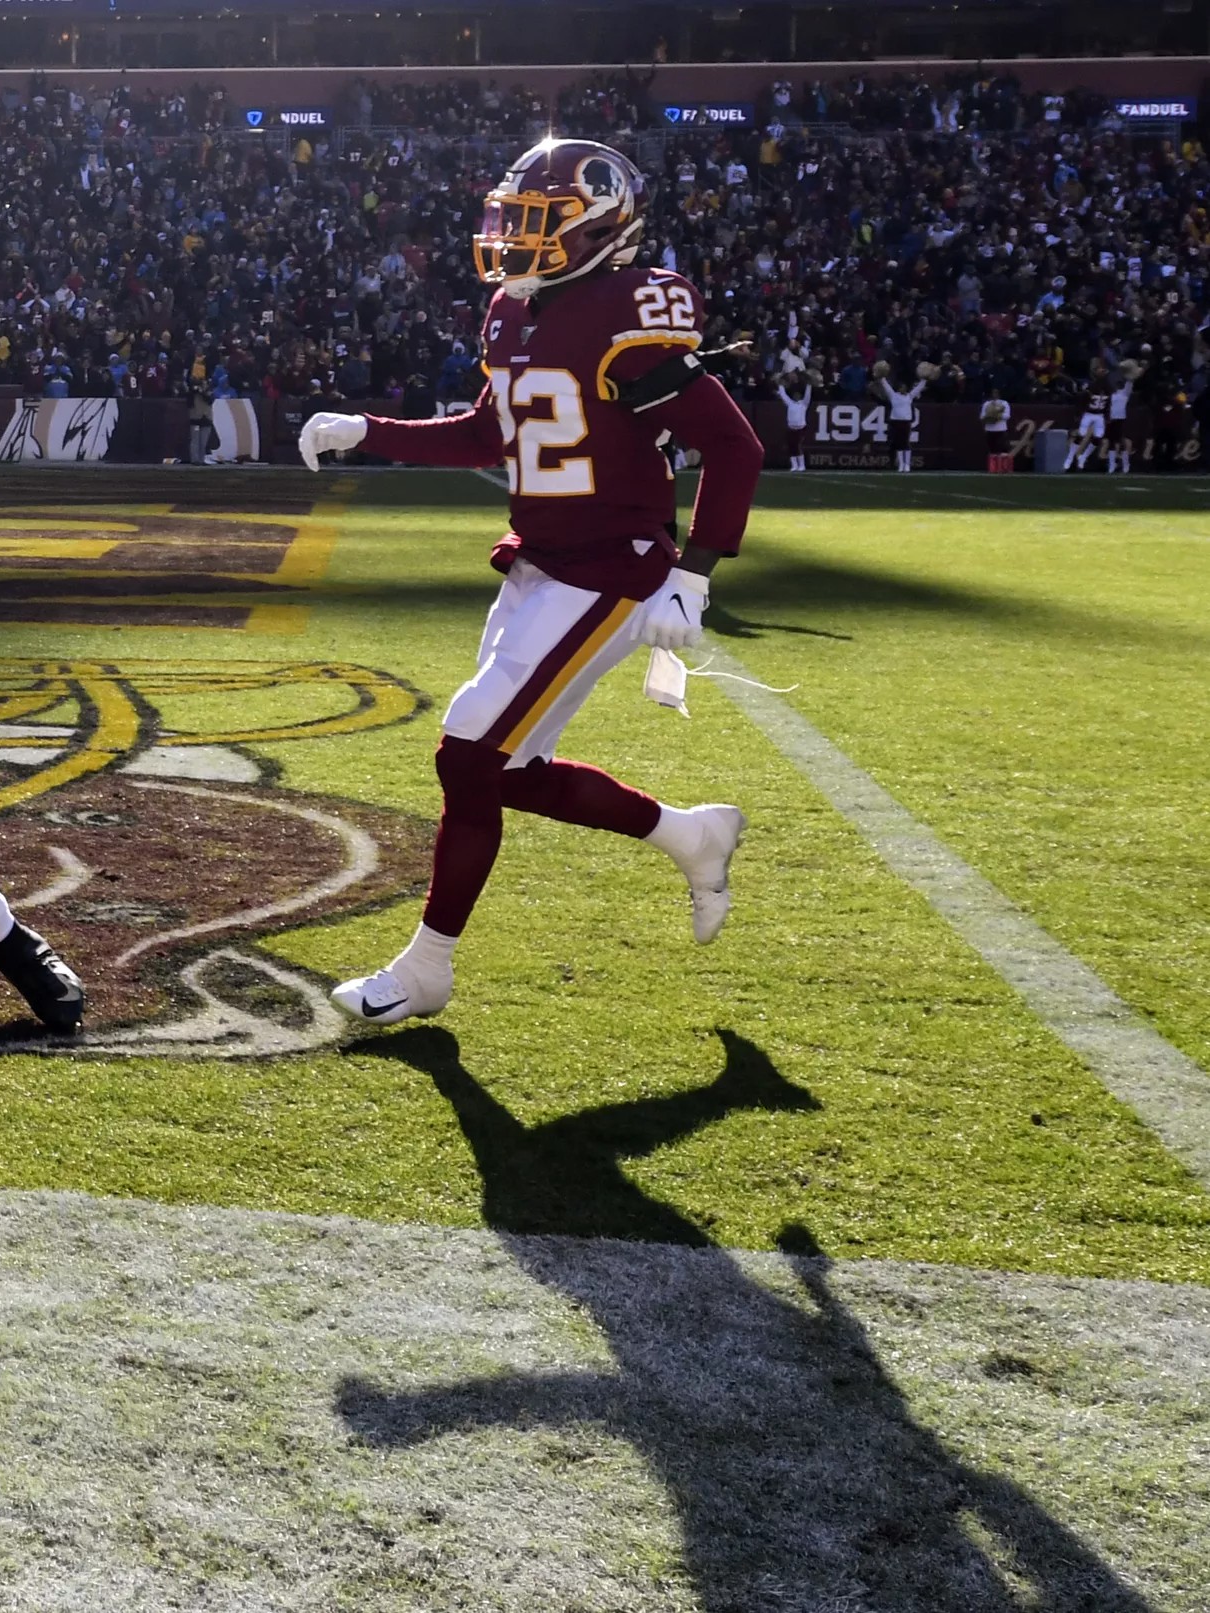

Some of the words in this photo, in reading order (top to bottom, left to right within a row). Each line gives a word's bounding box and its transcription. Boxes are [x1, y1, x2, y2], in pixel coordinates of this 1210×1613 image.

[682, 108, 746, 121] FDUEL
[1120, 103, 1190, 117] FANDUEL
[280, 112, 326, 125] NDUEL
[633, 284, 696, 328] 22
[809, 454, 837, 466] NFL
[839, 455, 925, 467] CHAMPS
